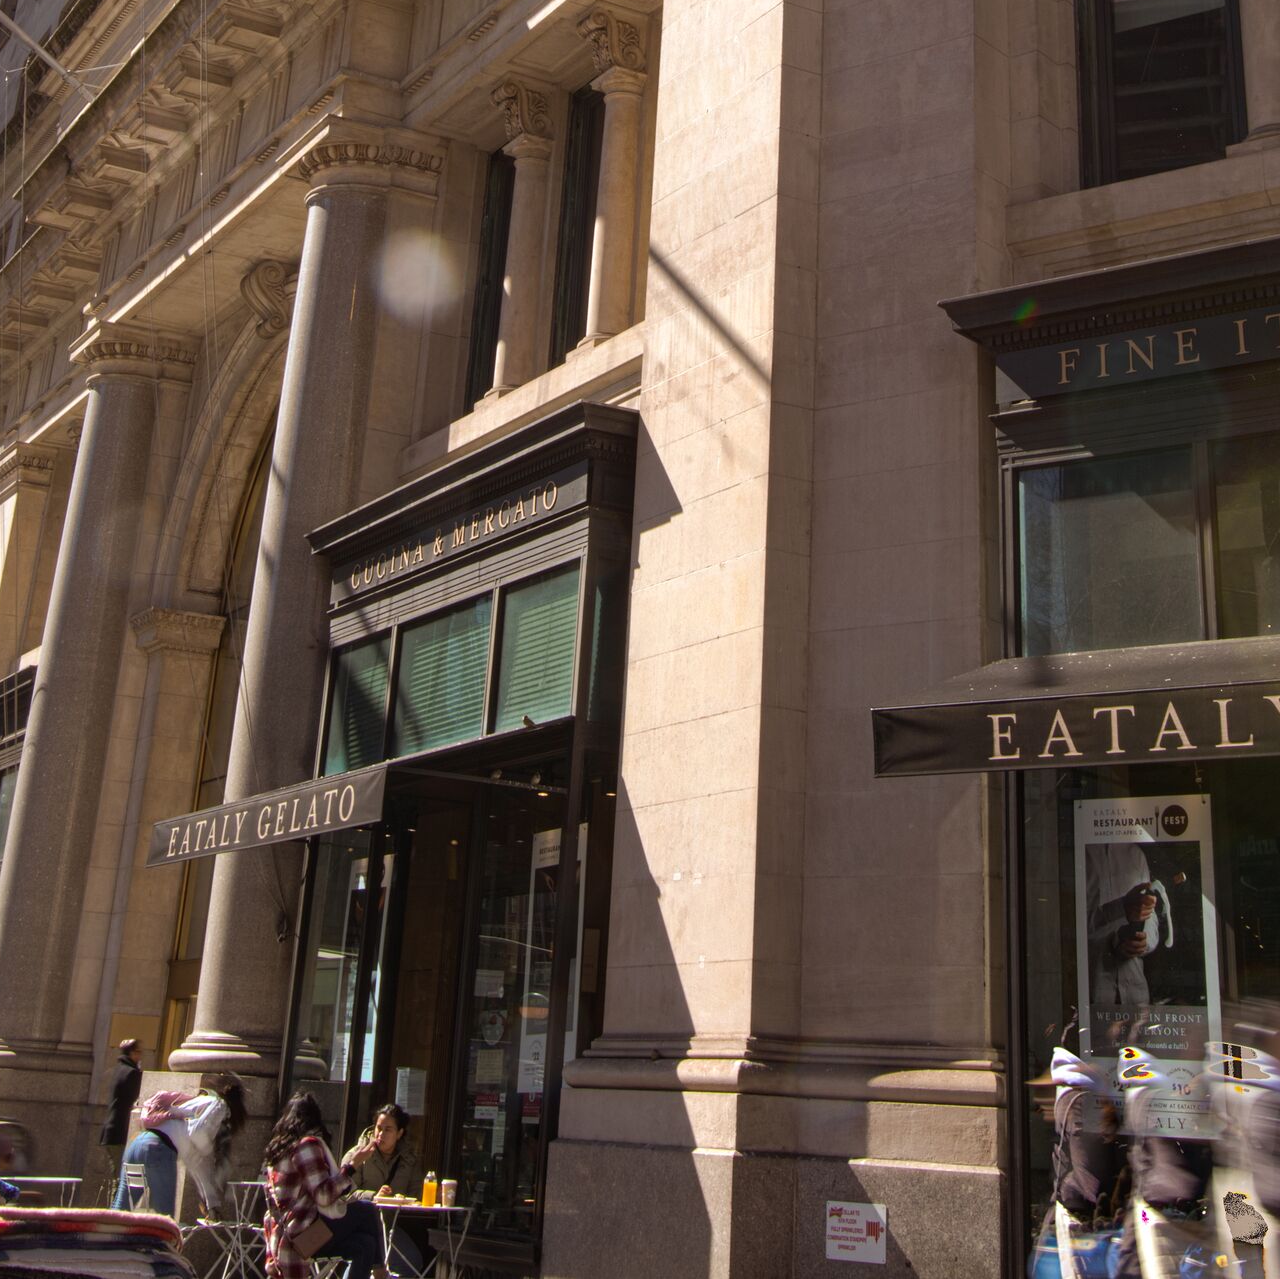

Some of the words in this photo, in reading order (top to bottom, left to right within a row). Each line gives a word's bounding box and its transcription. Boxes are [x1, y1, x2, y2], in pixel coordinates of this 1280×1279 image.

[1057, 327, 1201, 386] FINE
[351, 538, 424, 589] CUCINA
[432, 528, 444, 556] &
[451, 480, 558, 549] MERCATO
[166, 811, 248, 858] EATALY
[257, 784, 355, 840] GELATO
[1093, 808, 1128, 816] EATALY
[1093, 817, 1154, 828] RESTAURANT
[1164, 815, 1186, 825] FEST
[1114, 1012, 1130, 1020] DO
[1150, 1012, 1161, 1021] IN
[1165, 1013, 1202, 1024] FRONT
